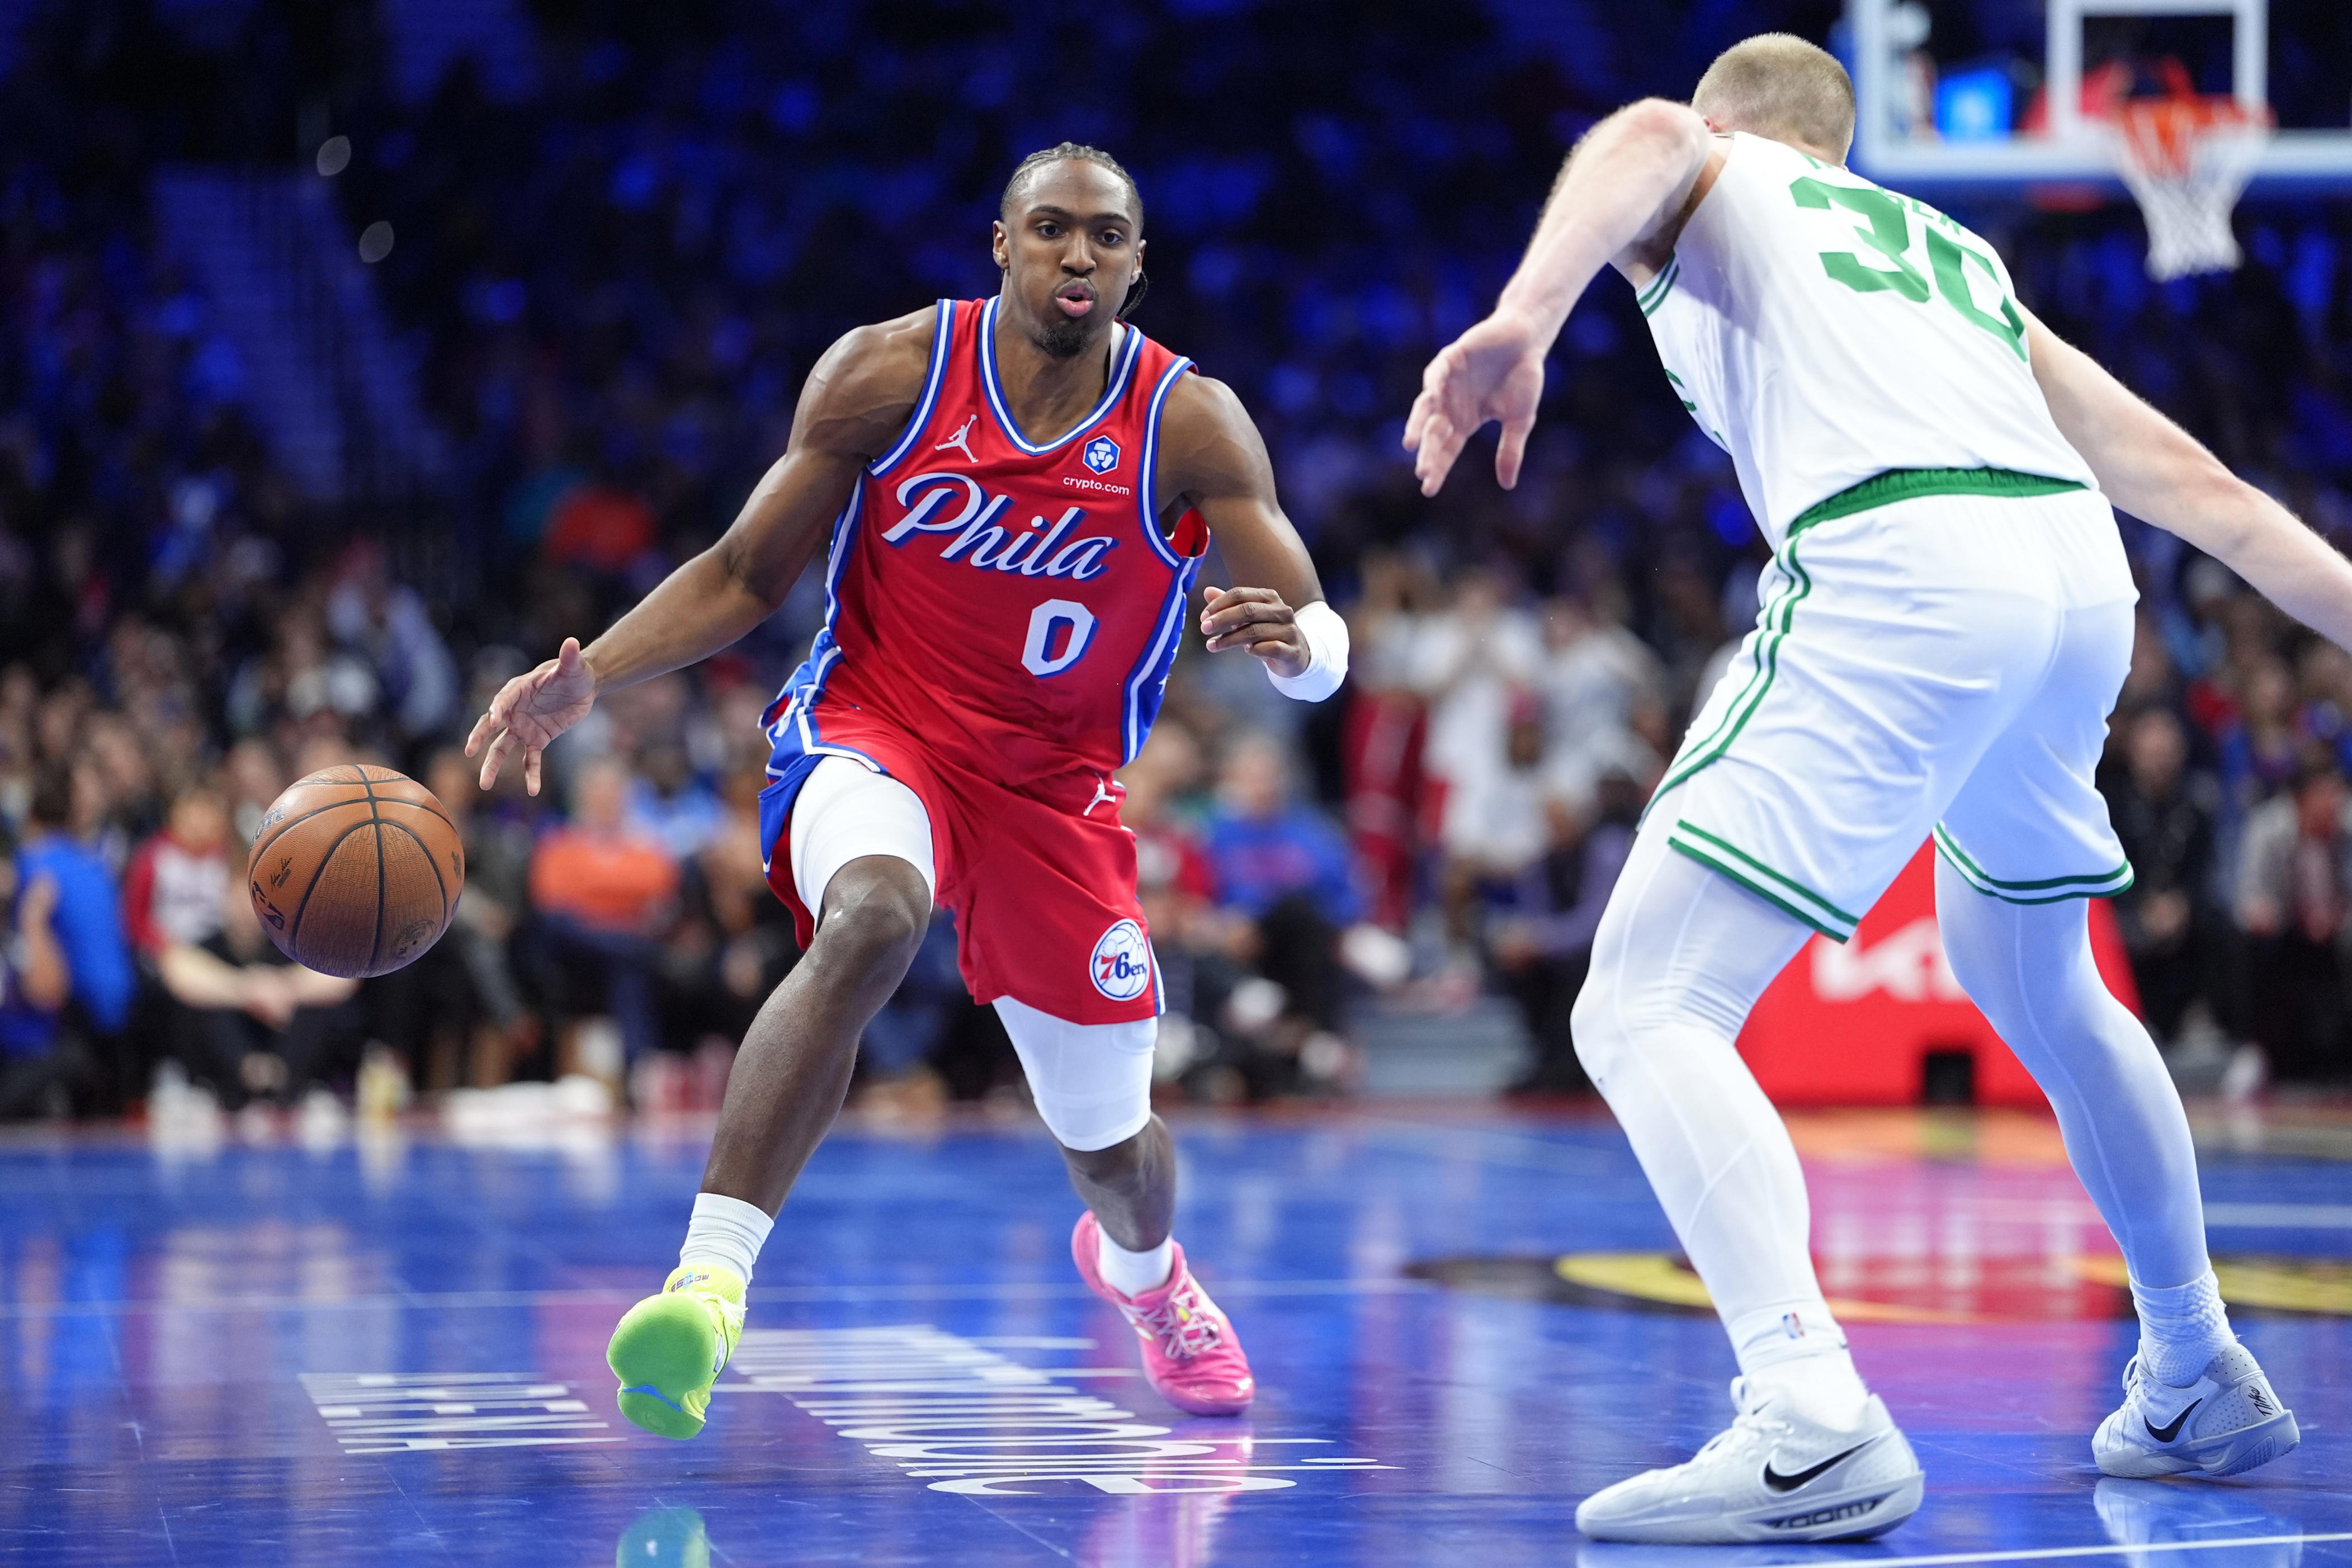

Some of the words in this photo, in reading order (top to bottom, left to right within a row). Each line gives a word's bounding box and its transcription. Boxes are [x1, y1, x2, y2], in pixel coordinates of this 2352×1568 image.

[1789, 176, 2028, 362] 30
[1063, 477, 1130, 495] crypto.com
[881, 472, 1116, 581] Phila
[1021, 598, 1098, 678] 0
[1100, 952, 1145, 979] 76ers
